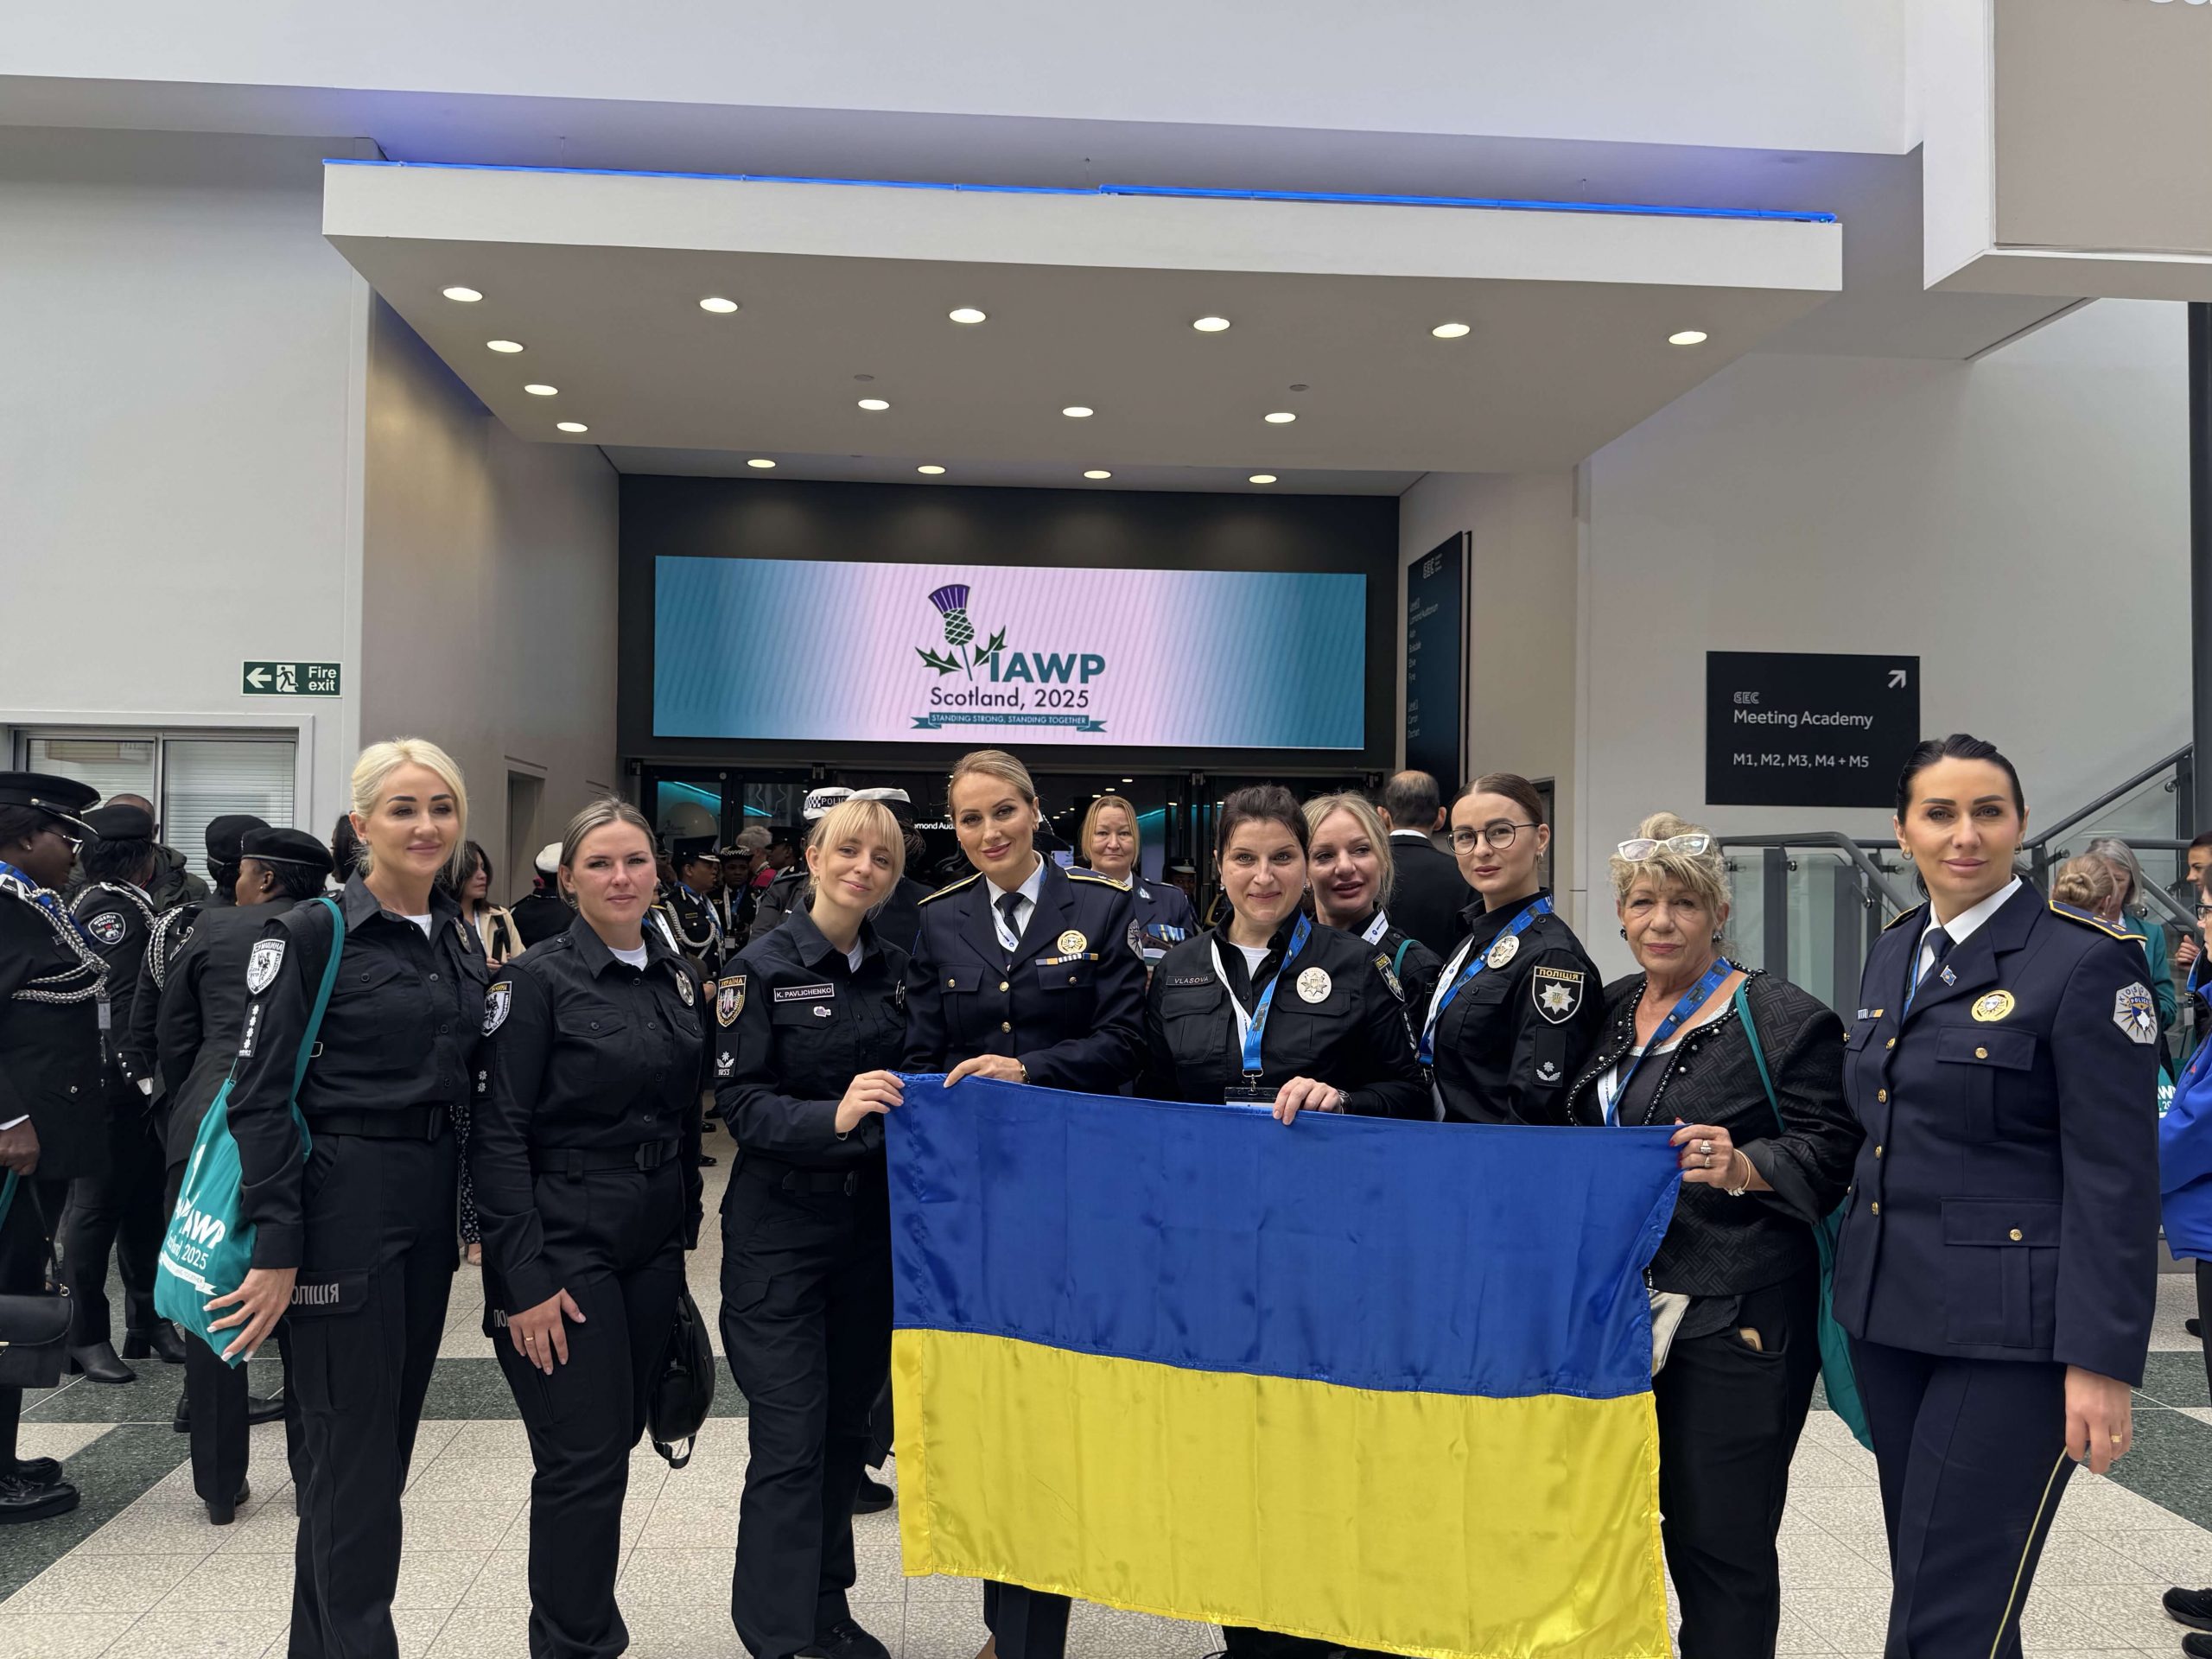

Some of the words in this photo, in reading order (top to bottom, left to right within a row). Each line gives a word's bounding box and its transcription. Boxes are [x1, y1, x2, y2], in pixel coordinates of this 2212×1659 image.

[308, 665, 336, 678] Fire
[990, 652, 1106, 683] IAWP
[308, 679, 335, 691] exit
[930, 686, 1026, 711] Scotland,
[1034, 689, 1089, 708] 2025
[931, 714, 971, 722] STANDING
[972, 715, 1007, 724] STRONG,
[1007, 715, 1047, 724] STANDING
[1733, 709, 1798, 728] Meeting
[1801, 710, 1873, 730] Academy
[1733, 753, 1758, 766] M1,
[1761, 754, 1784, 767] M2,
[1788, 754, 1812, 768] M3,
[1815, 755, 1835, 767] M4
[1849, 756, 1869, 767] M5
[821, 797, 847, 805] POLIC
[1539, 969, 1579, 981] ПОЛІЦІЯ
[785, 987, 832, 997] PAVLICHENKO
[181, 1244, 209, 1270] 2025
[290, 1283, 340, 1306] ОЛІЦІЯ
